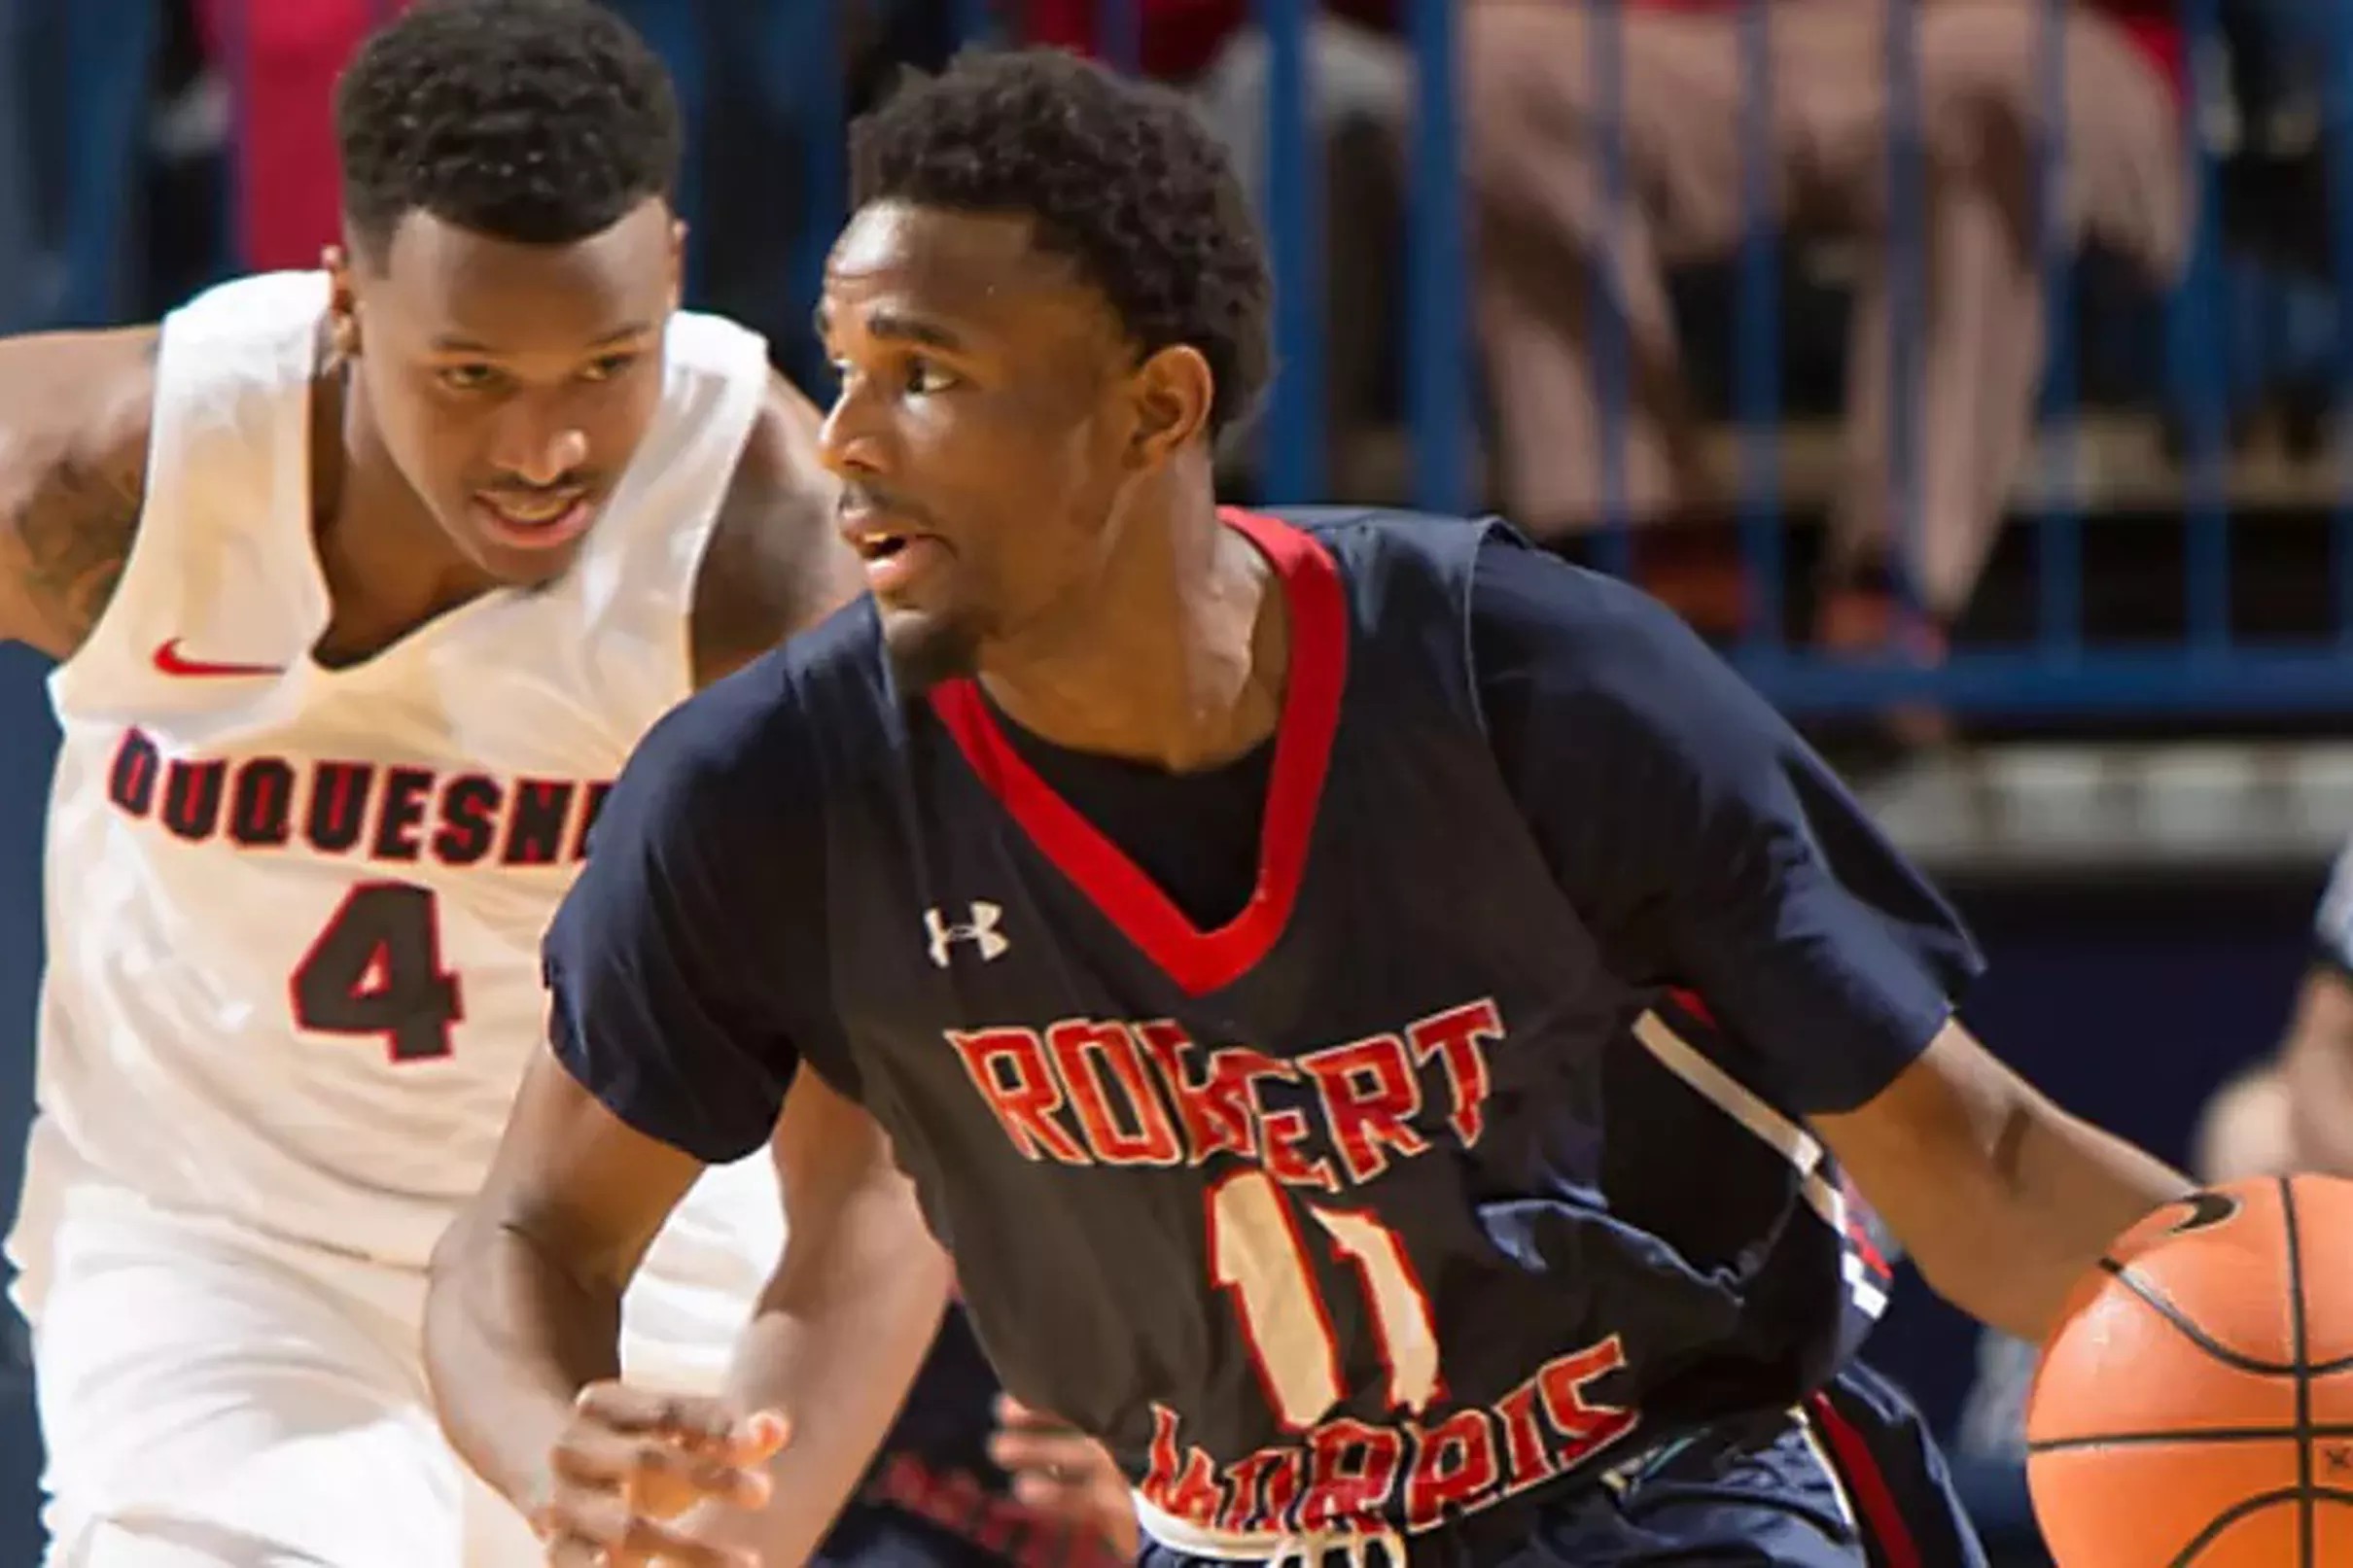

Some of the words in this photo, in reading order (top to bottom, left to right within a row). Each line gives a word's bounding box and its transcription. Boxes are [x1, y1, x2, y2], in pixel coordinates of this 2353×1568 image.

[289, 880, 465, 1063] 4
[943, 997, 1504, 1192] ROBERT
[1204, 1169, 1451, 1431] 11
